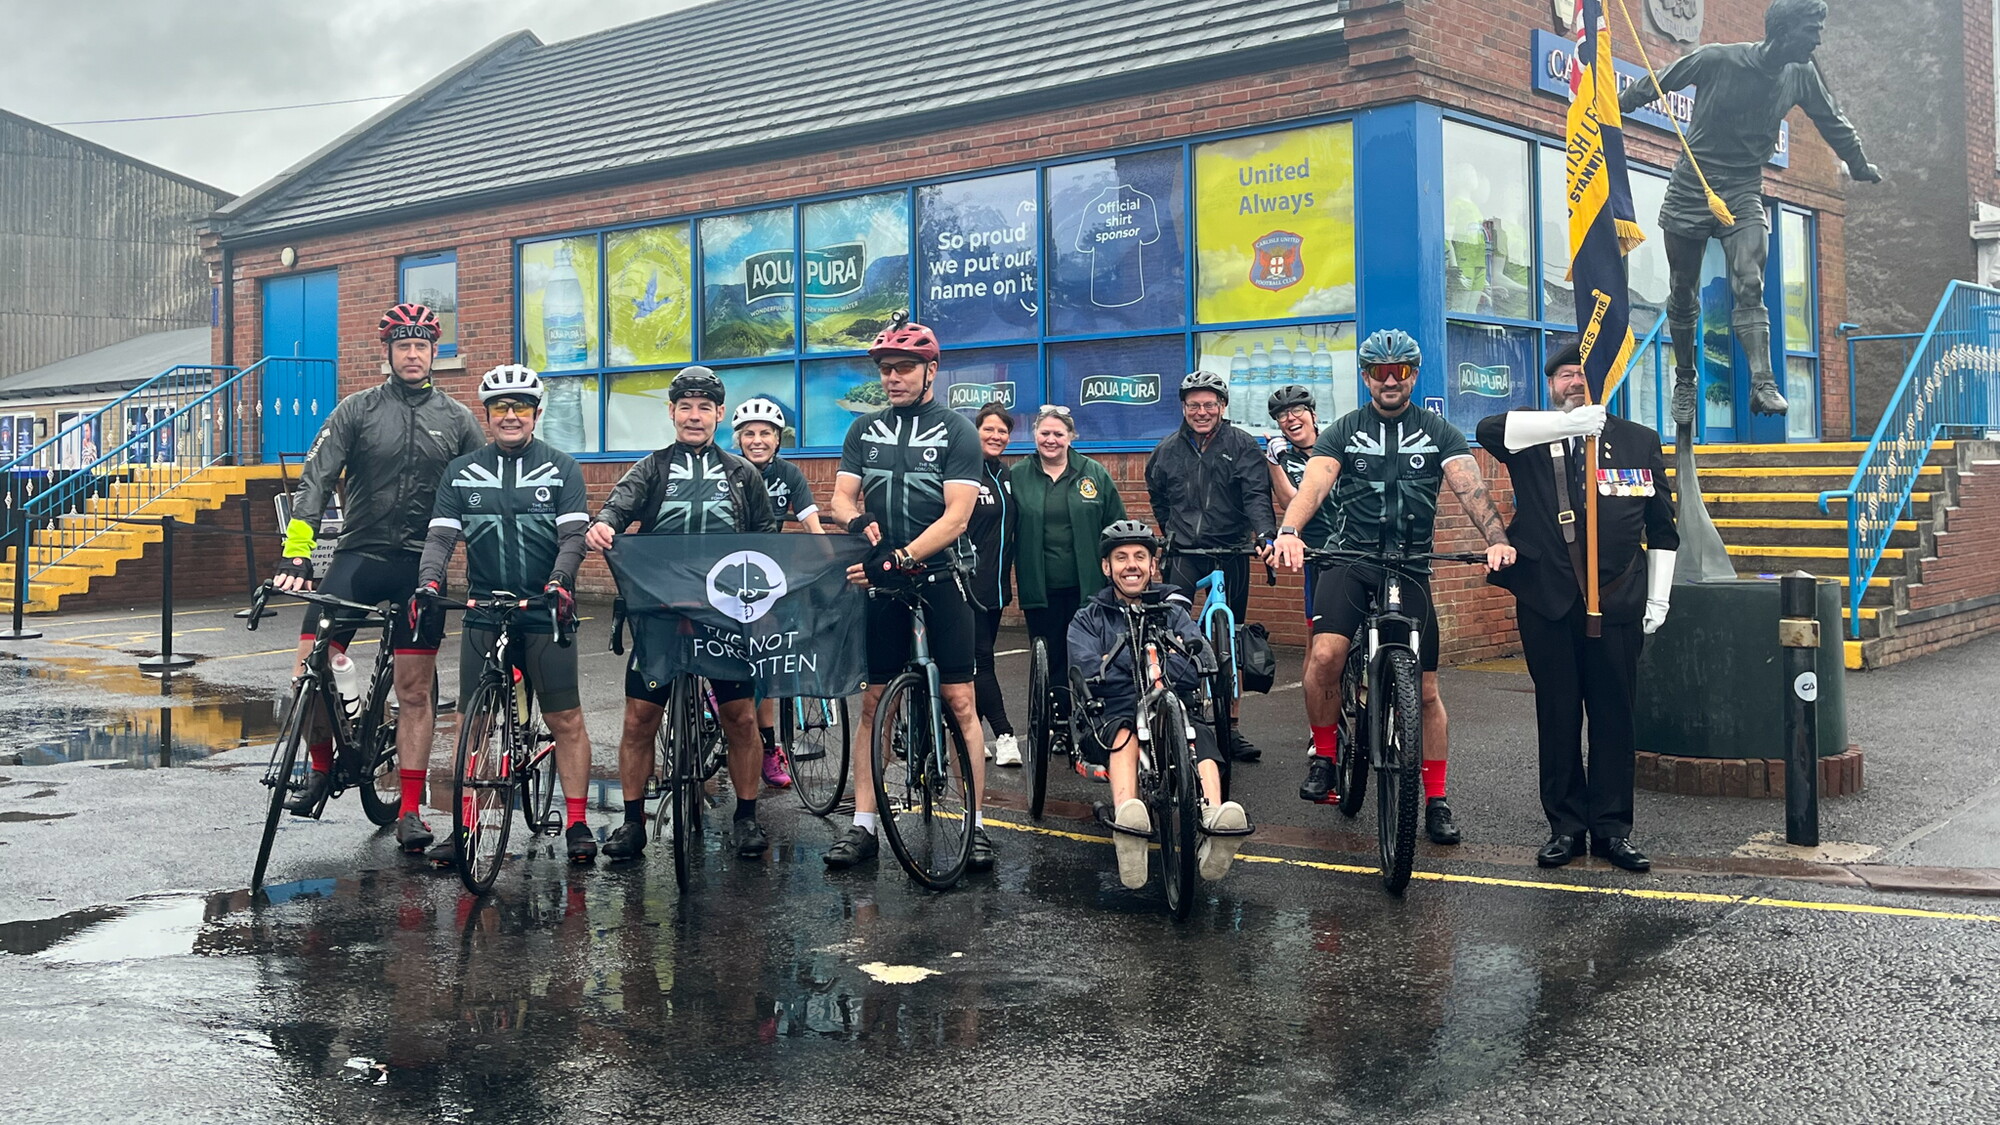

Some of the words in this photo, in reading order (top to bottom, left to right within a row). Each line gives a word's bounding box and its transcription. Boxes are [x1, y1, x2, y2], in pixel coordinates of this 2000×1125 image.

[1239, 157, 1310, 186] United
[1097, 198, 1140, 214] Official
[1239, 192, 1314, 215] Always
[1105, 214, 1132, 227] shirt
[938, 232, 964, 250] So
[969, 222, 1026, 252] proud
[1095, 227, 1141, 243] sponsor
[752, 260, 795, 290] AQU
[806, 256, 857, 286] PURA
[930, 259, 958, 276] we
[964, 253, 1000, 277] put
[1004, 250, 1032, 269] our
[930, 282, 987, 300] name
[993, 279, 1016, 296] on
[1020, 271, 1034, 292] it
[392, 325, 431, 339] DEVON
[1579, 331, 1596, 361] PRES
[1593, 300, 1607, 326] 2018
[1085, 381, 1120, 399] AQUA
[1120, 382, 1156, 398] PURA
[1461, 369, 1480, 387] AQUA
[1480, 373, 1508, 390] PURA
[951, 389, 980, 405] AQUA
[981, 389, 1011, 404] PURA
[749, 631, 799, 656] NOT
